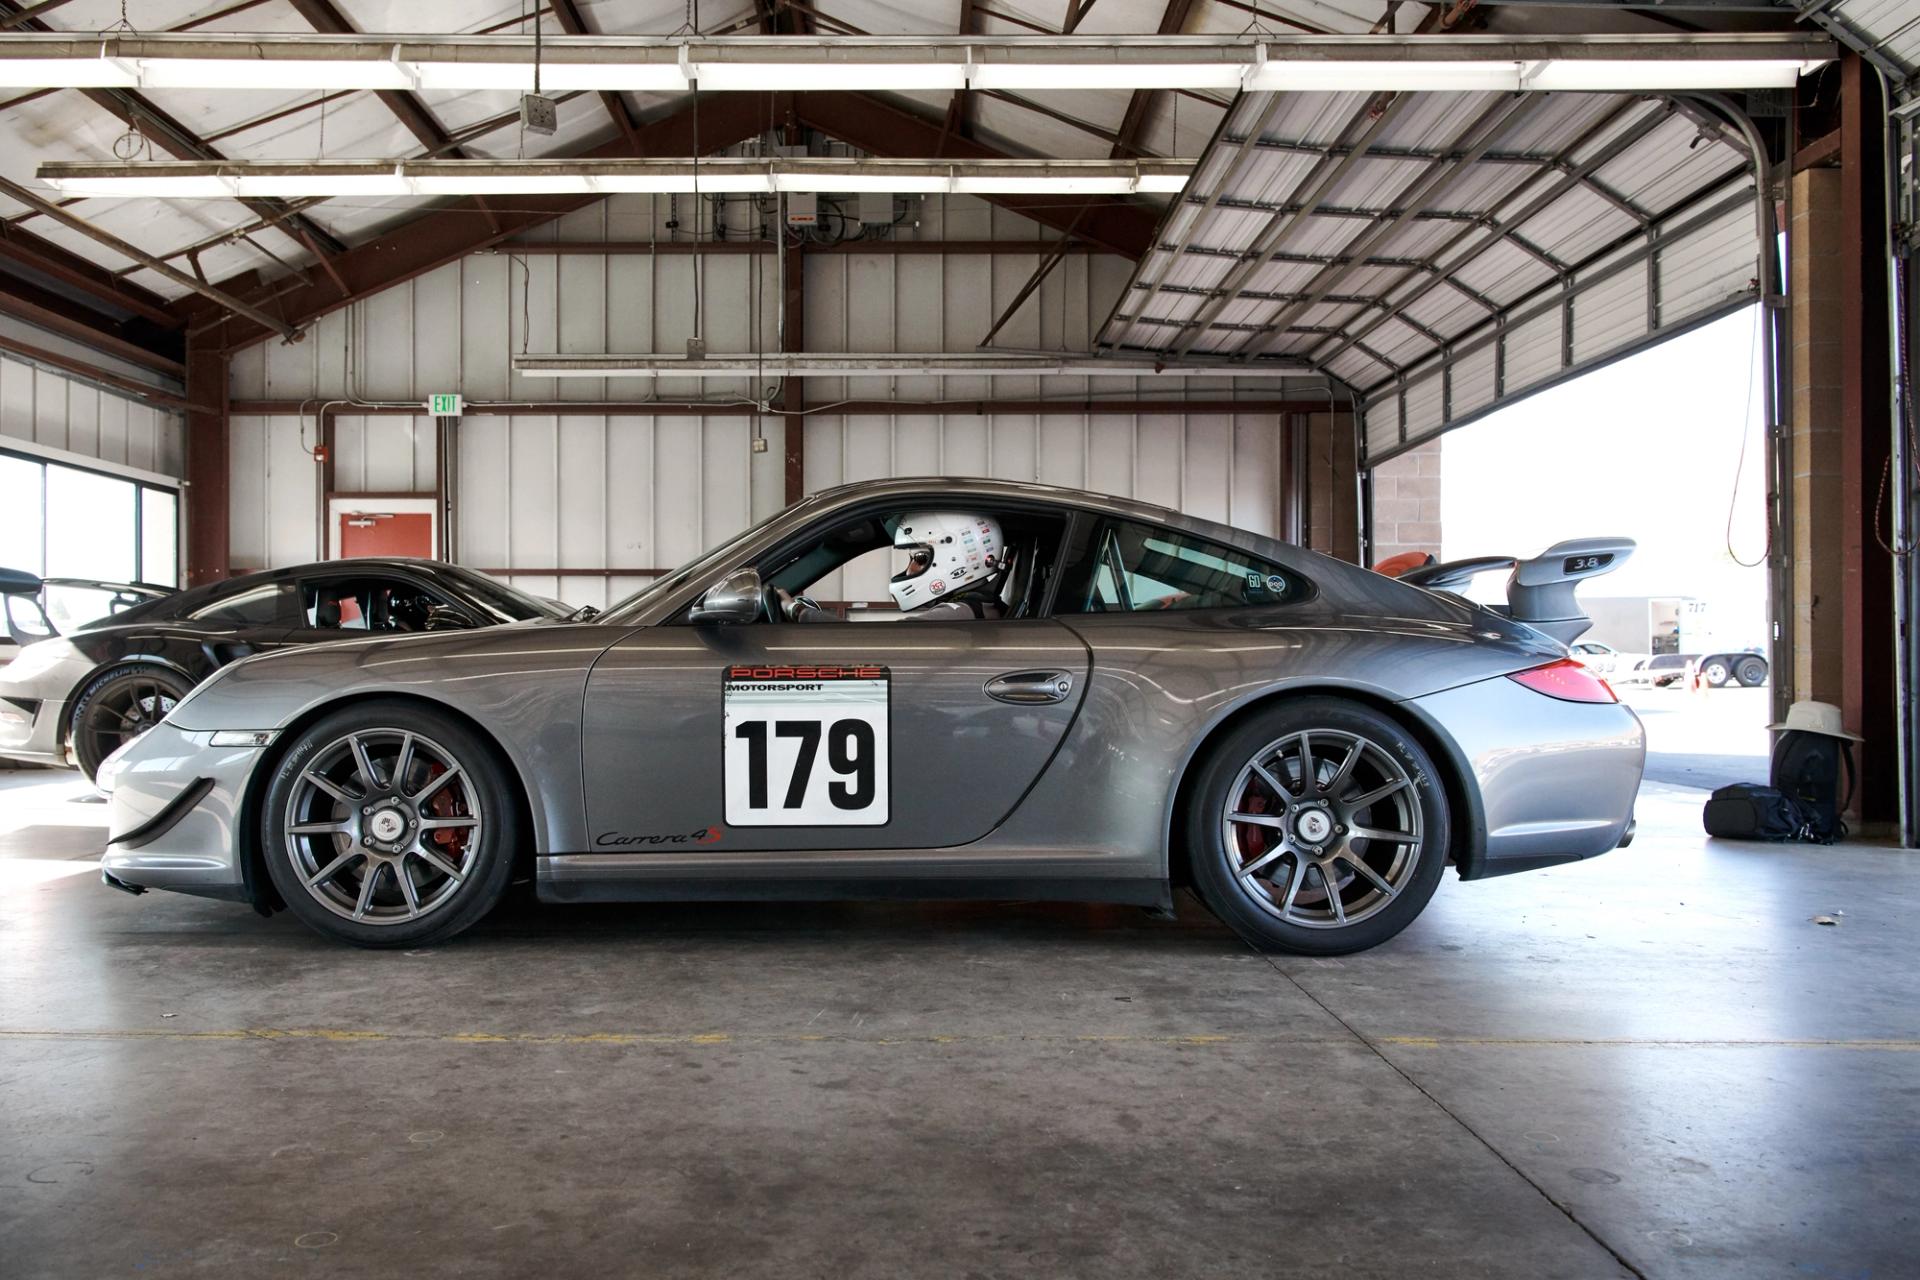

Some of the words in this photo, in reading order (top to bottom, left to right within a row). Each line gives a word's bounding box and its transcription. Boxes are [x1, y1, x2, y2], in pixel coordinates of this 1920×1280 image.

[434, 395, 456, 413] EXIT
[1574, 557, 1599, 569] 3.8
[731, 668, 881, 679] PORSCHE
[728, 683, 824, 692] MOTORSPORT
[735, 718, 876, 811] 179
[596, 831, 687, 846] Carrera
